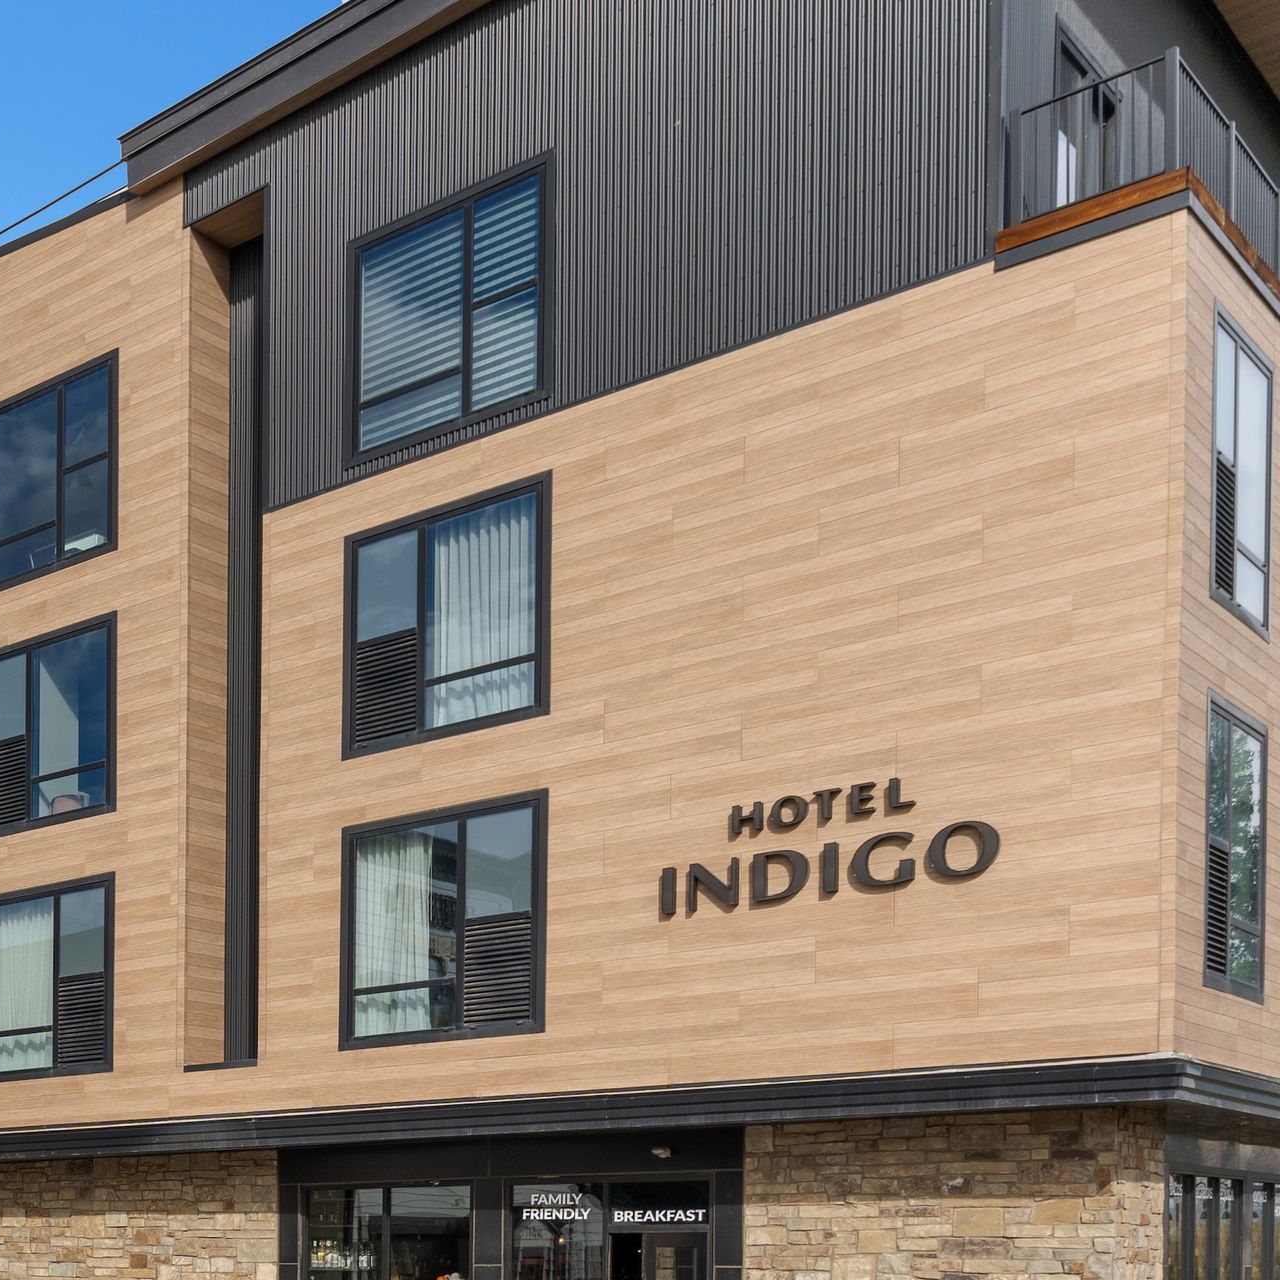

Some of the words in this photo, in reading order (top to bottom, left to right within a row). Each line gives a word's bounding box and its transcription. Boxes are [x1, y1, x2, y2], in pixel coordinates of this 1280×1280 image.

[730, 777, 917, 835] HOTEL
[661, 820, 1001, 915] INDIGO
[530, 1193, 583, 1205] FAMILY
[522, 1208, 591, 1220] FRIENDLY
[613, 1209, 706, 1222] BREAKFAST
